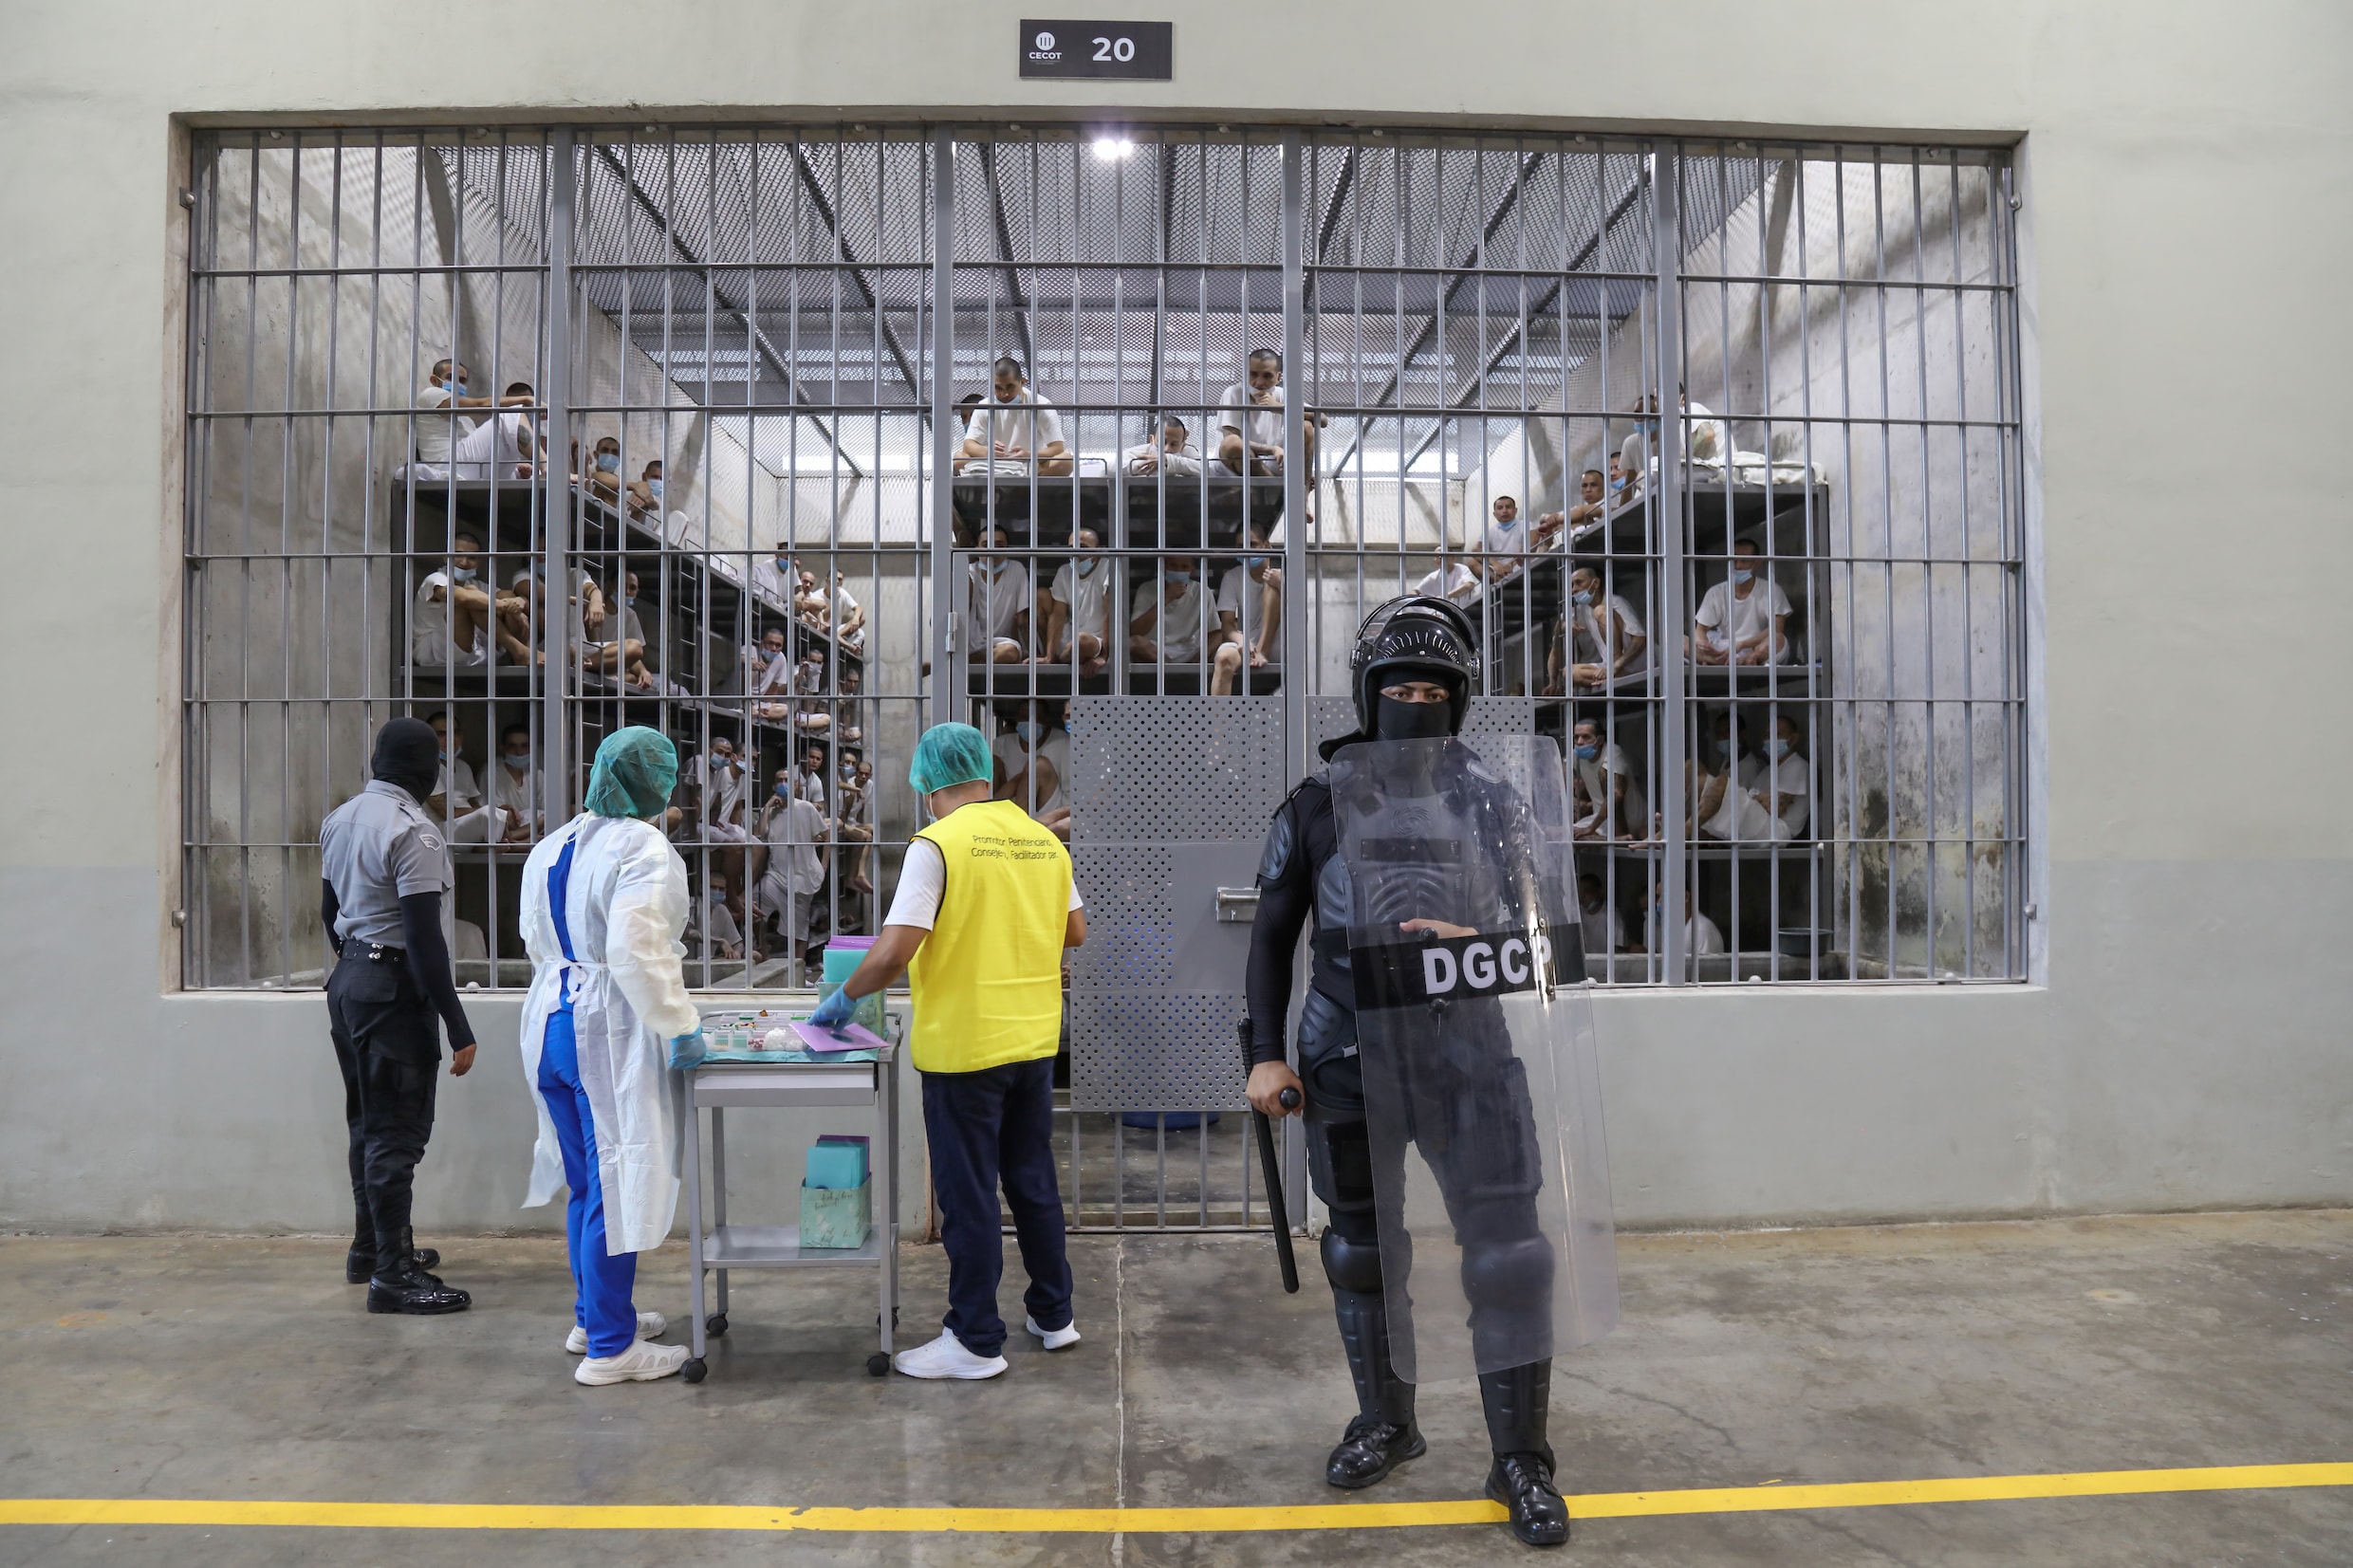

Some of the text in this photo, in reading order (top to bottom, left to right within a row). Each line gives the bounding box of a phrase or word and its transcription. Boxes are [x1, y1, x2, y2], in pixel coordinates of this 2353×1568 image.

[1028, 51, 1062, 60] CECOT
[1092, 37, 1136, 63] 20
[1421, 935, 1552, 995] DGCP
